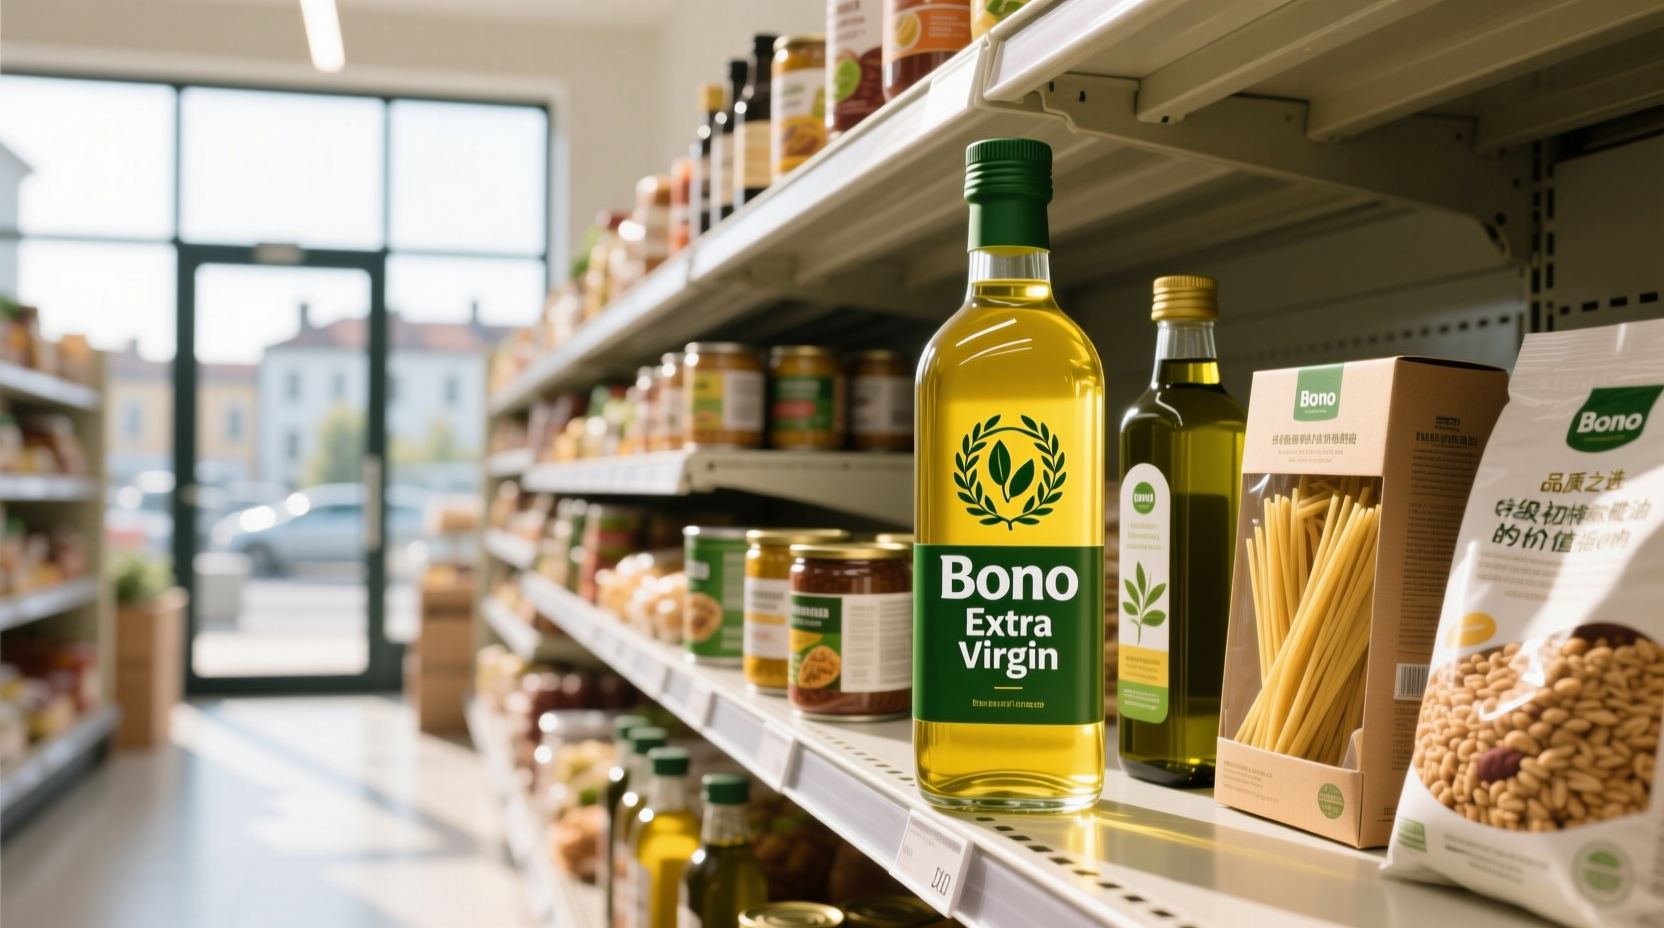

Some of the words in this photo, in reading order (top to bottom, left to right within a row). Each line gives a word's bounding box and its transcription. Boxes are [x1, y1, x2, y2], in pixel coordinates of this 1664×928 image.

[1300, 390, 1336, 407] Bono
[1577, 411, 1643, 434] Bono
[940, 554, 1079, 601] Bono
[966, 607, 1052, 637] Extra
[958, 640, 1058, 679] Virgin
